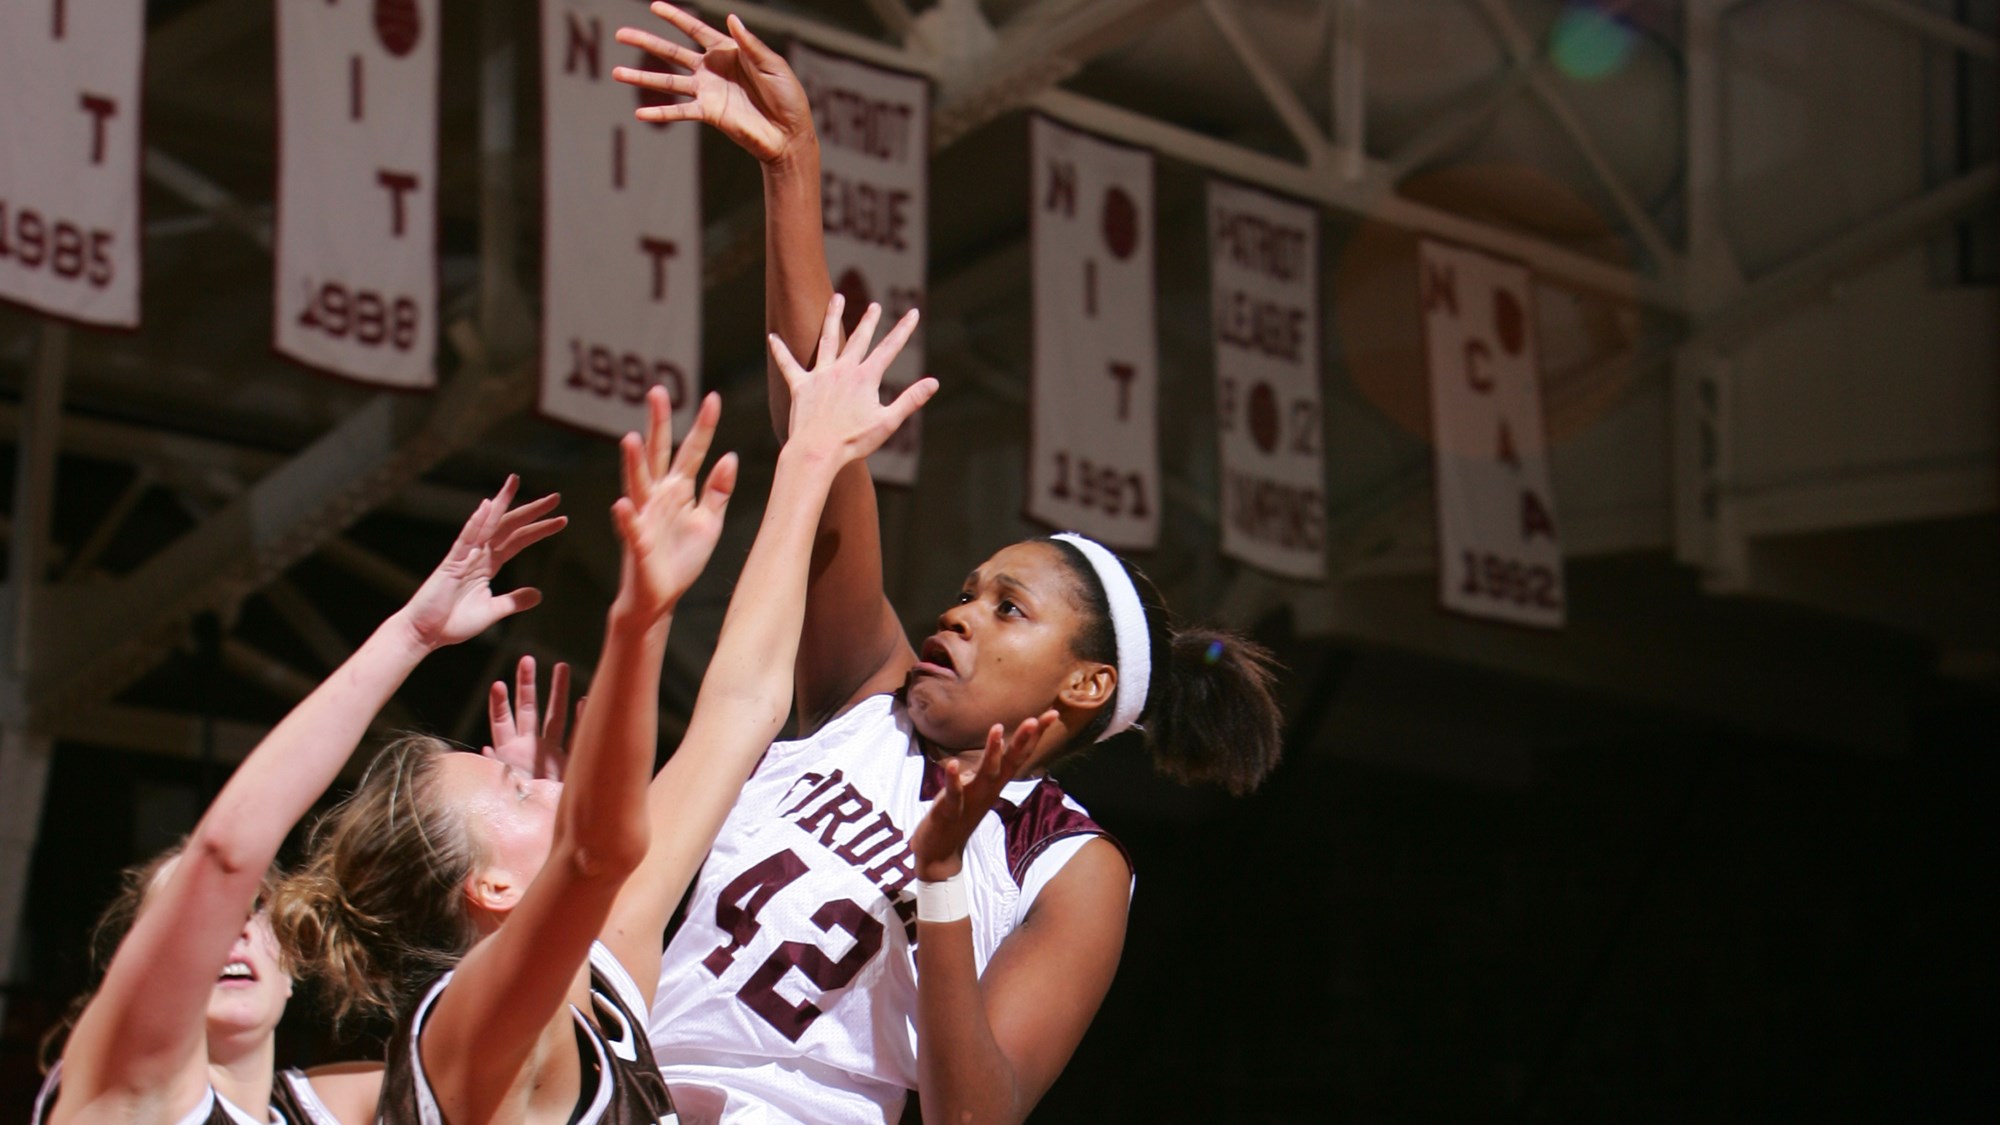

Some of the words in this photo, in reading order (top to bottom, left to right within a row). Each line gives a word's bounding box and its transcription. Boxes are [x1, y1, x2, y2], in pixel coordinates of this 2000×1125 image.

[565, 11, 600, 80] N
[79, 91, 118, 165] T
[377, 168, 420, 239] T
[822, 172, 911, 252] EAGUE
[640, 234, 677, 302] T
[296, 279, 419, 352] 1988
[566, 336, 688, 410] 1990
[1107, 357, 1138, 423] T
[1049, 451, 1152, 519] 1991
[1460, 545, 1558, 610] 1992
[702, 847, 884, 1043] 42
